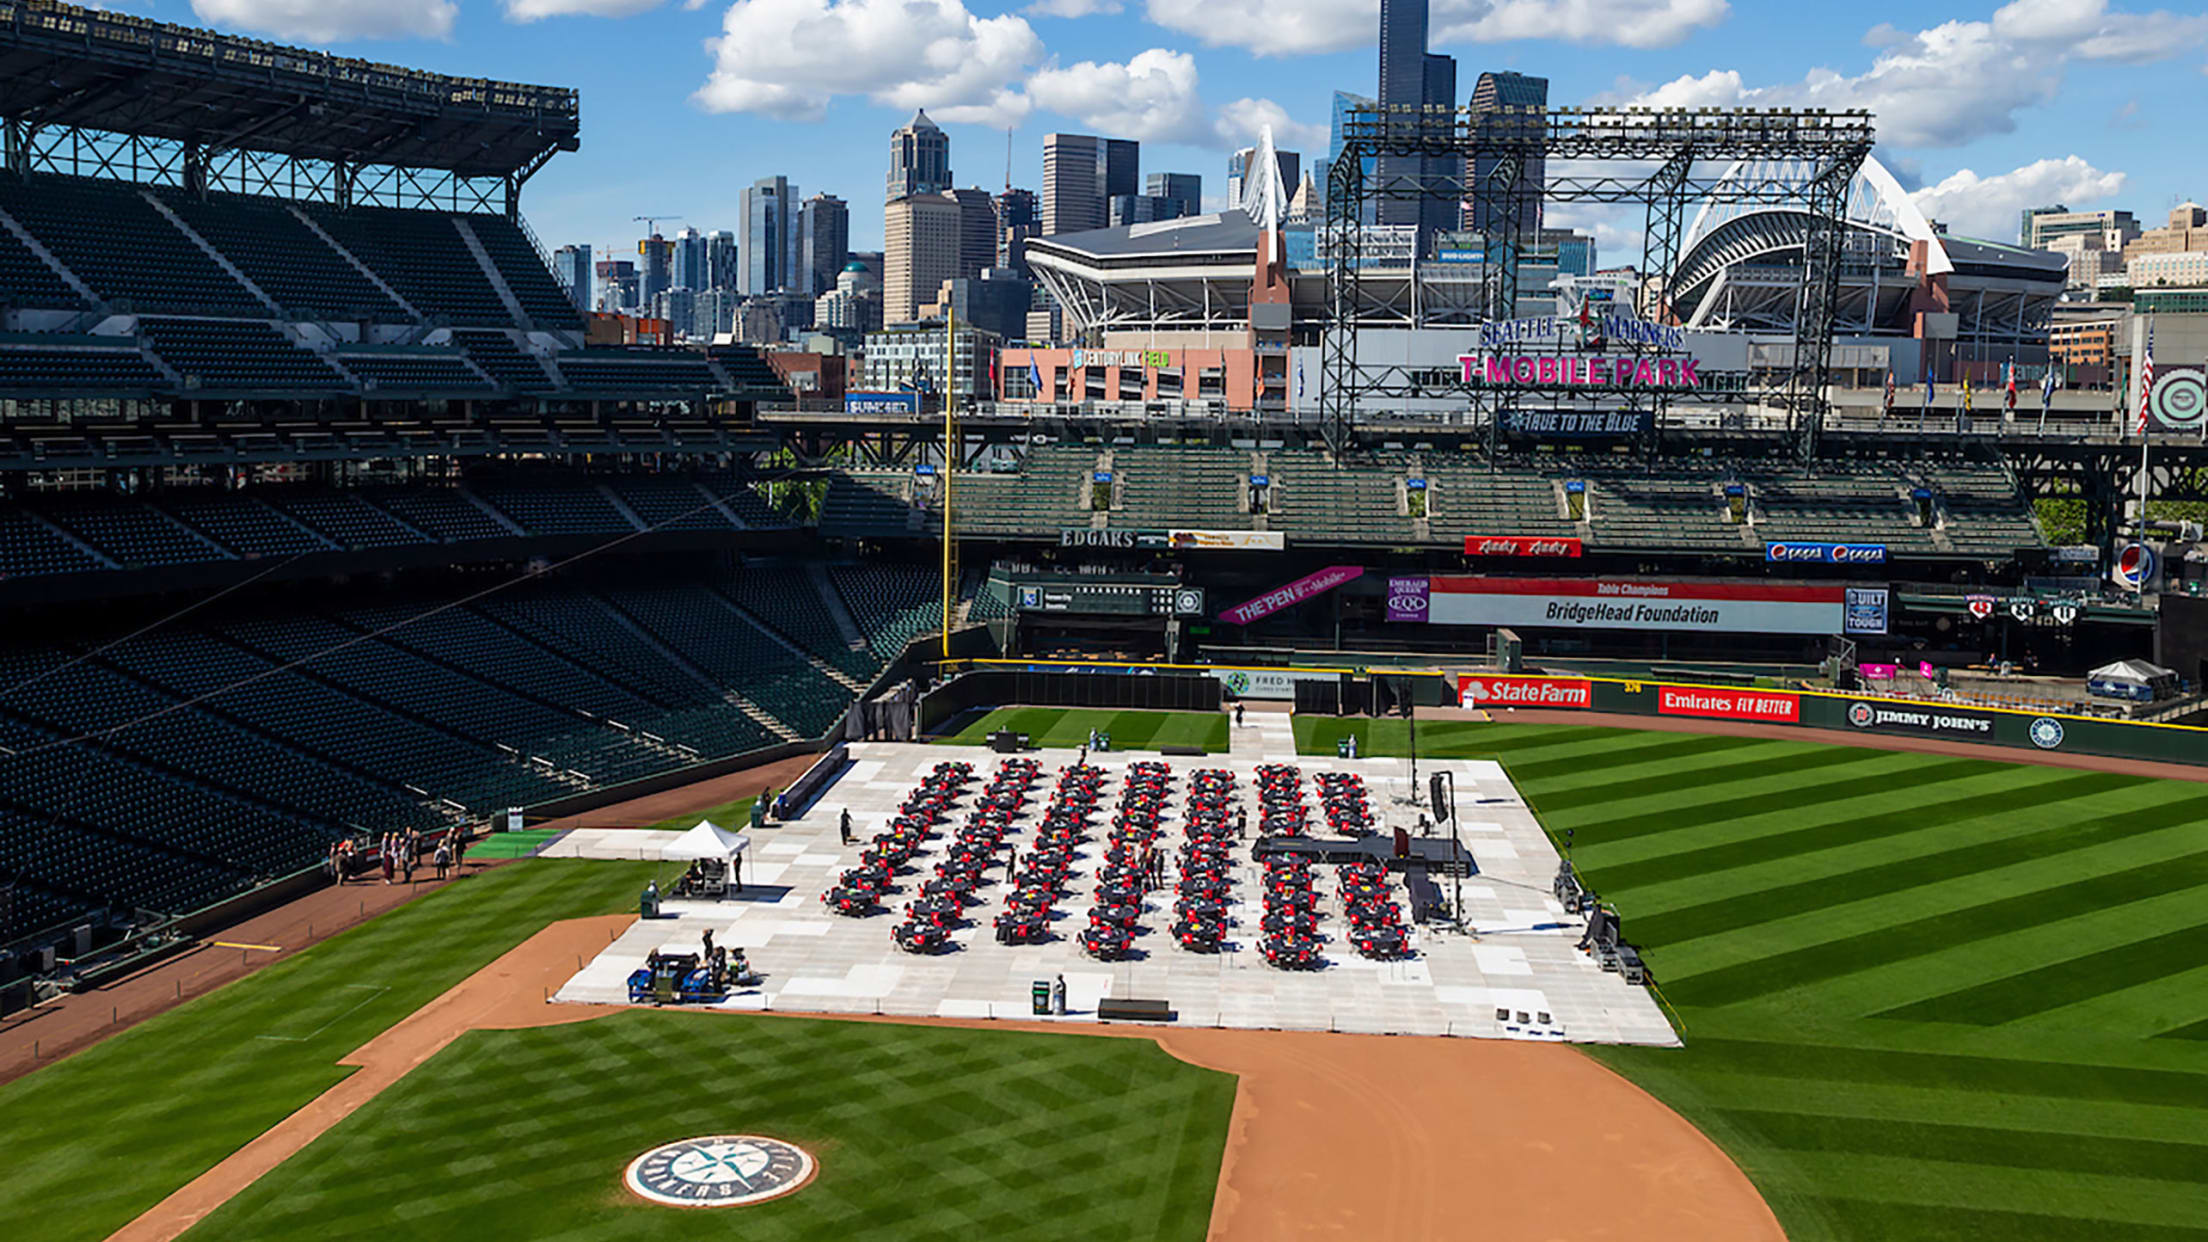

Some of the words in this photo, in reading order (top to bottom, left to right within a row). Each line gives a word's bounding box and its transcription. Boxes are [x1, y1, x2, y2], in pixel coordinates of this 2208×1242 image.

[1479, 316, 1556, 347] SEATTLE
[1603, 315, 1685, 349] MARINERS
[1459, 356, 1606, 385] T-MOBILE
[1615, 358, 1701, 386] PARK
[1523, 411, 1559, 432] TRUE
[1559, 412, 1578, 432] TO
[1578, 412, 1603, 432] THE
[1605, 411, 1641, 432] BLUE
[1598, 583, 1620, 594] Table
[1621, 584, 1669, 597] Champions
[1235, 600, 1265, 621] THE
[1546, 601, 1634, 624] BridgeHead
[1635, 604, 1719, 623] Foundation
[1849, 617, 1883, 628] TOUGH
[1255, 676, 1284, 685] FRED
[1665, 693, 1732, 711] Emirates
[1736, 697, 1754, 712] FLY
[1755, 698, 1793, 714] BETTER
[1875, 709, 1929, 726] JIMMY
[1933, 714, 1992, 731] JOHN'S
